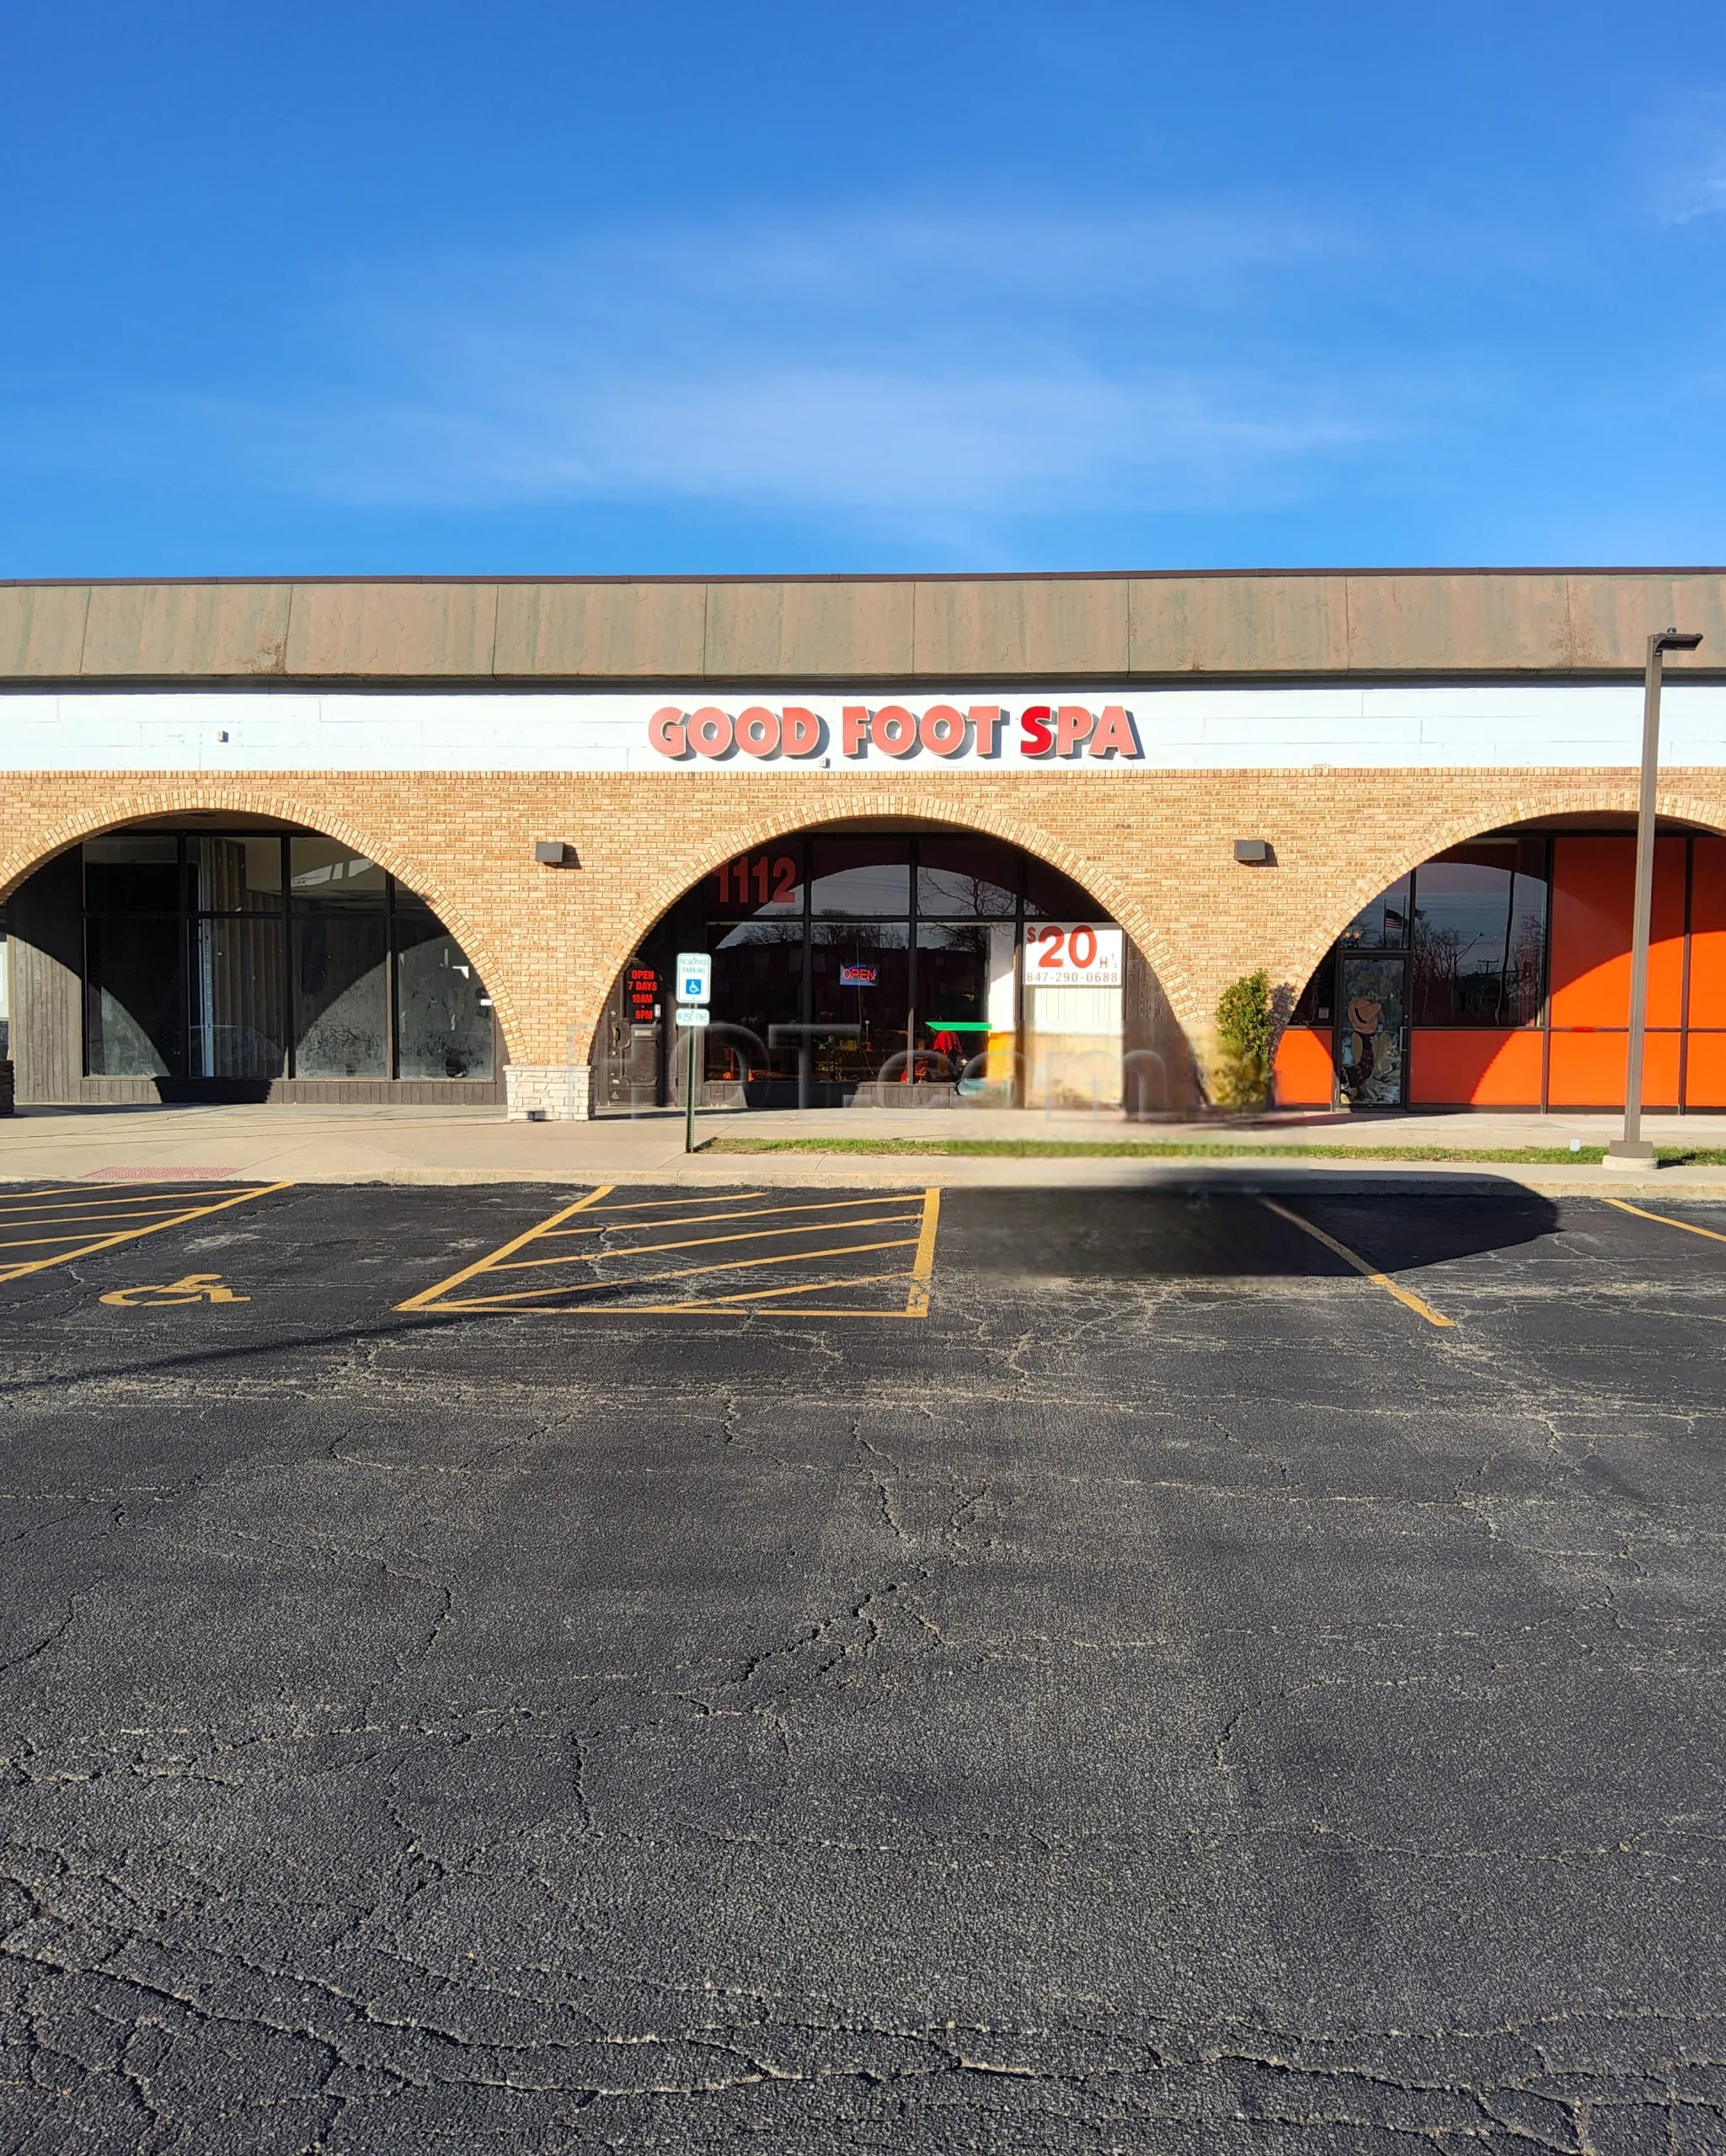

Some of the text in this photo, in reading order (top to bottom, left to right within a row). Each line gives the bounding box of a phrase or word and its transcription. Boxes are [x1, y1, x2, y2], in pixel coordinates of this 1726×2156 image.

[648, 705, 1138, 758] GOOD FOOT SPA
[713, 857, 796, 903] 1112
[1027, 924, 1098, 969] $20
[631, 969, 655, 980] OPEN
[842, 969, 876, 980] OPEN
[1026, 972, 1119, 983] 847-290-0688
[628, 981, 657, 991] 7 DAYS
[632, 994, 653, 1003] 10AM
[635, 1010, 653, 1020] 9PM
[696, 1013, 708, 1022] FINE
